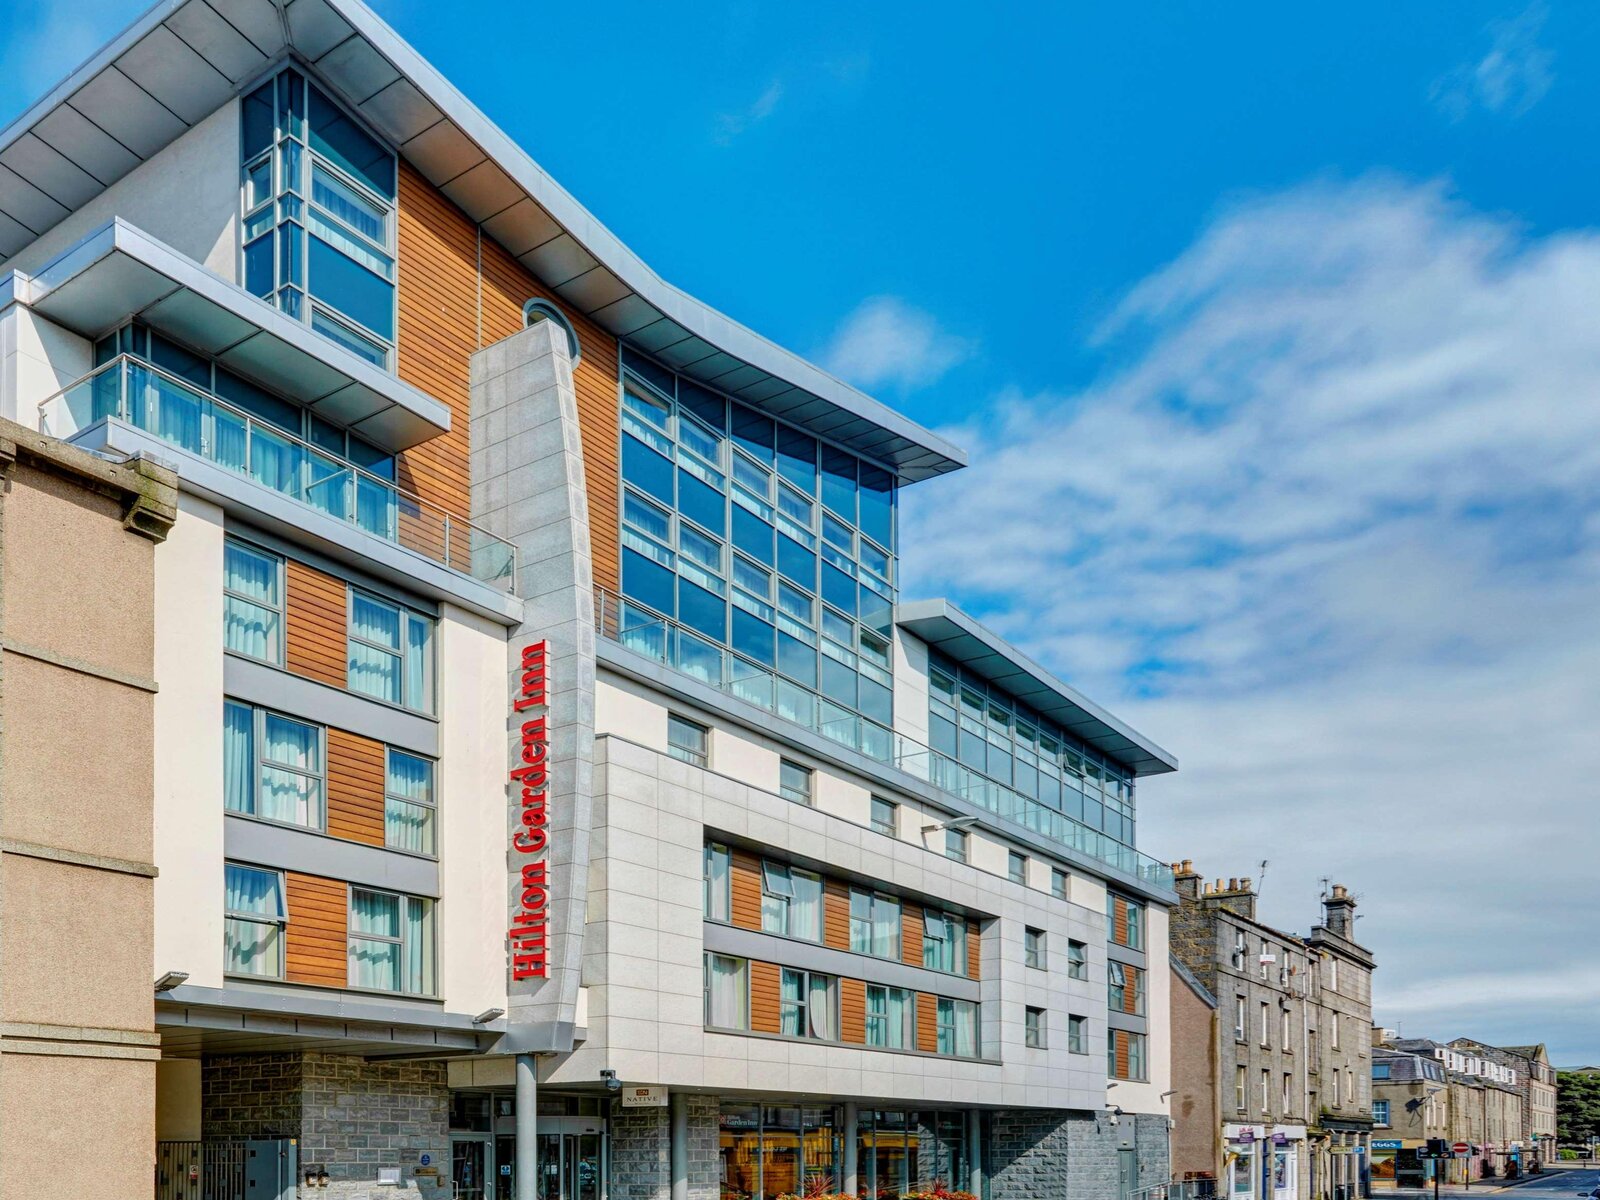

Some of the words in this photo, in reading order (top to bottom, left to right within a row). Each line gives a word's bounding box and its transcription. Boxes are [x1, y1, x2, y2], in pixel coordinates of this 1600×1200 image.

[513, 639, 546, 712] Inn
[510, 715, 546, 853] Garden
[509, 859, 546, 981] Hilton
